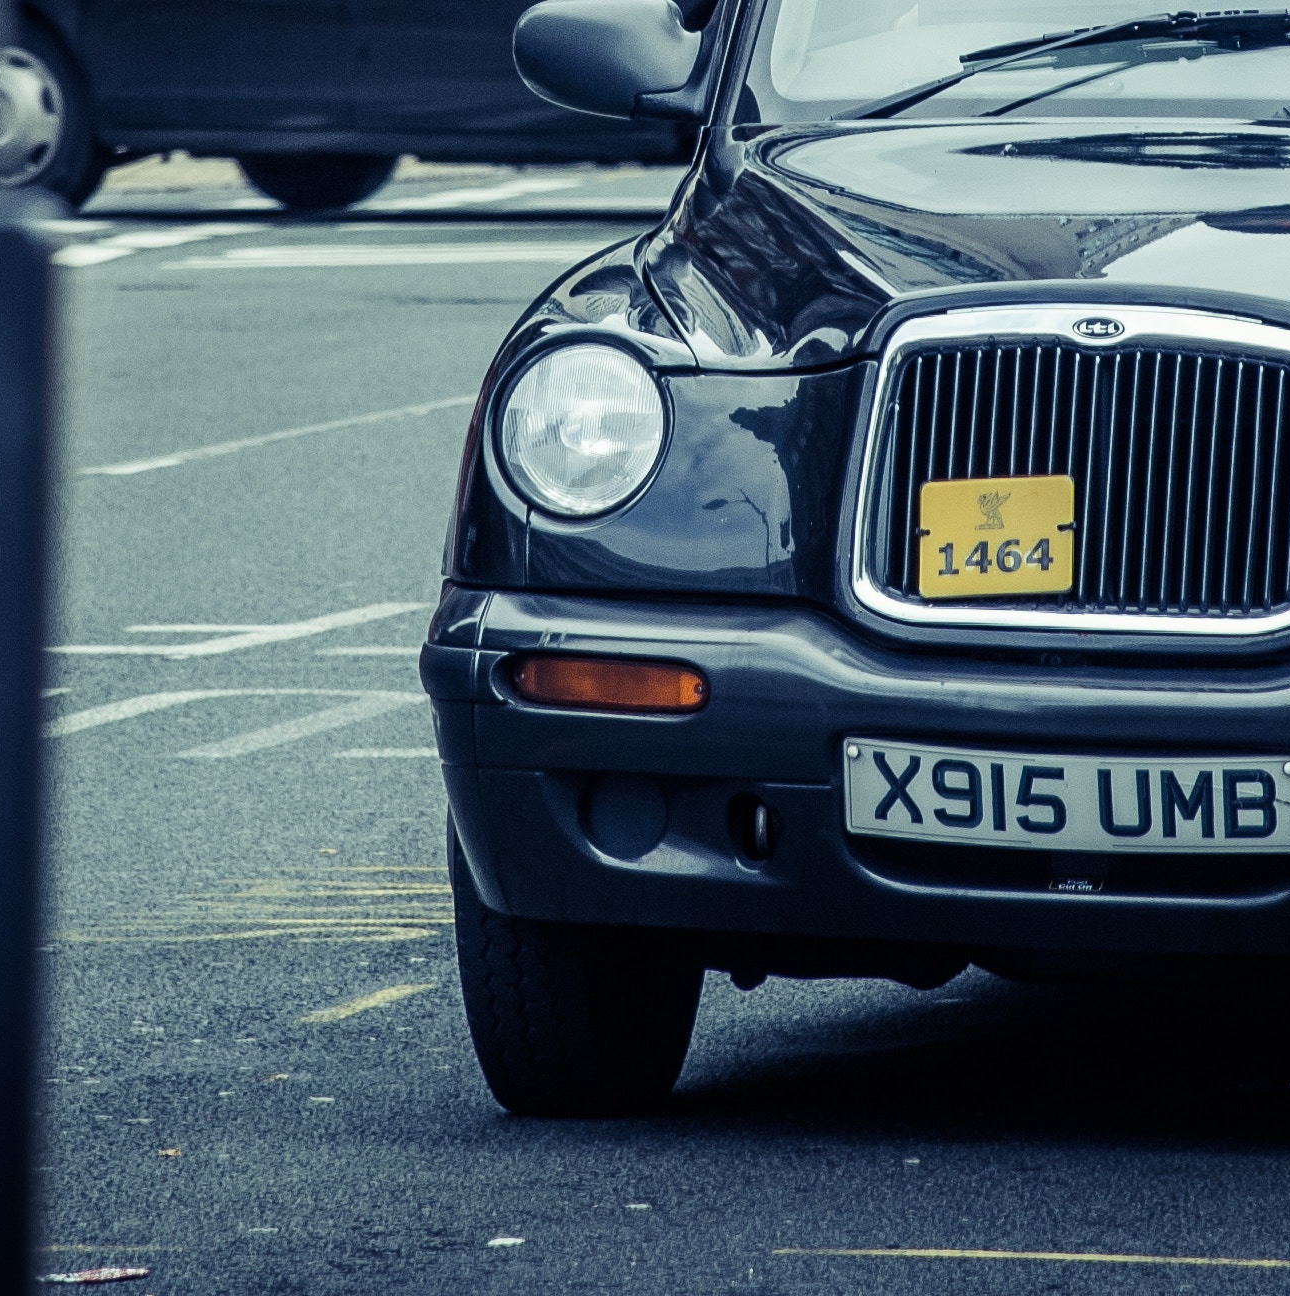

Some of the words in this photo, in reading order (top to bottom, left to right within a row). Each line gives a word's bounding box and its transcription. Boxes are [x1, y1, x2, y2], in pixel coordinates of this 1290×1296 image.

[937, 537, 1054, 576] 1464
[871, 750, 1067, 834] X915
[1097, 768, 1278, 840] UMB
